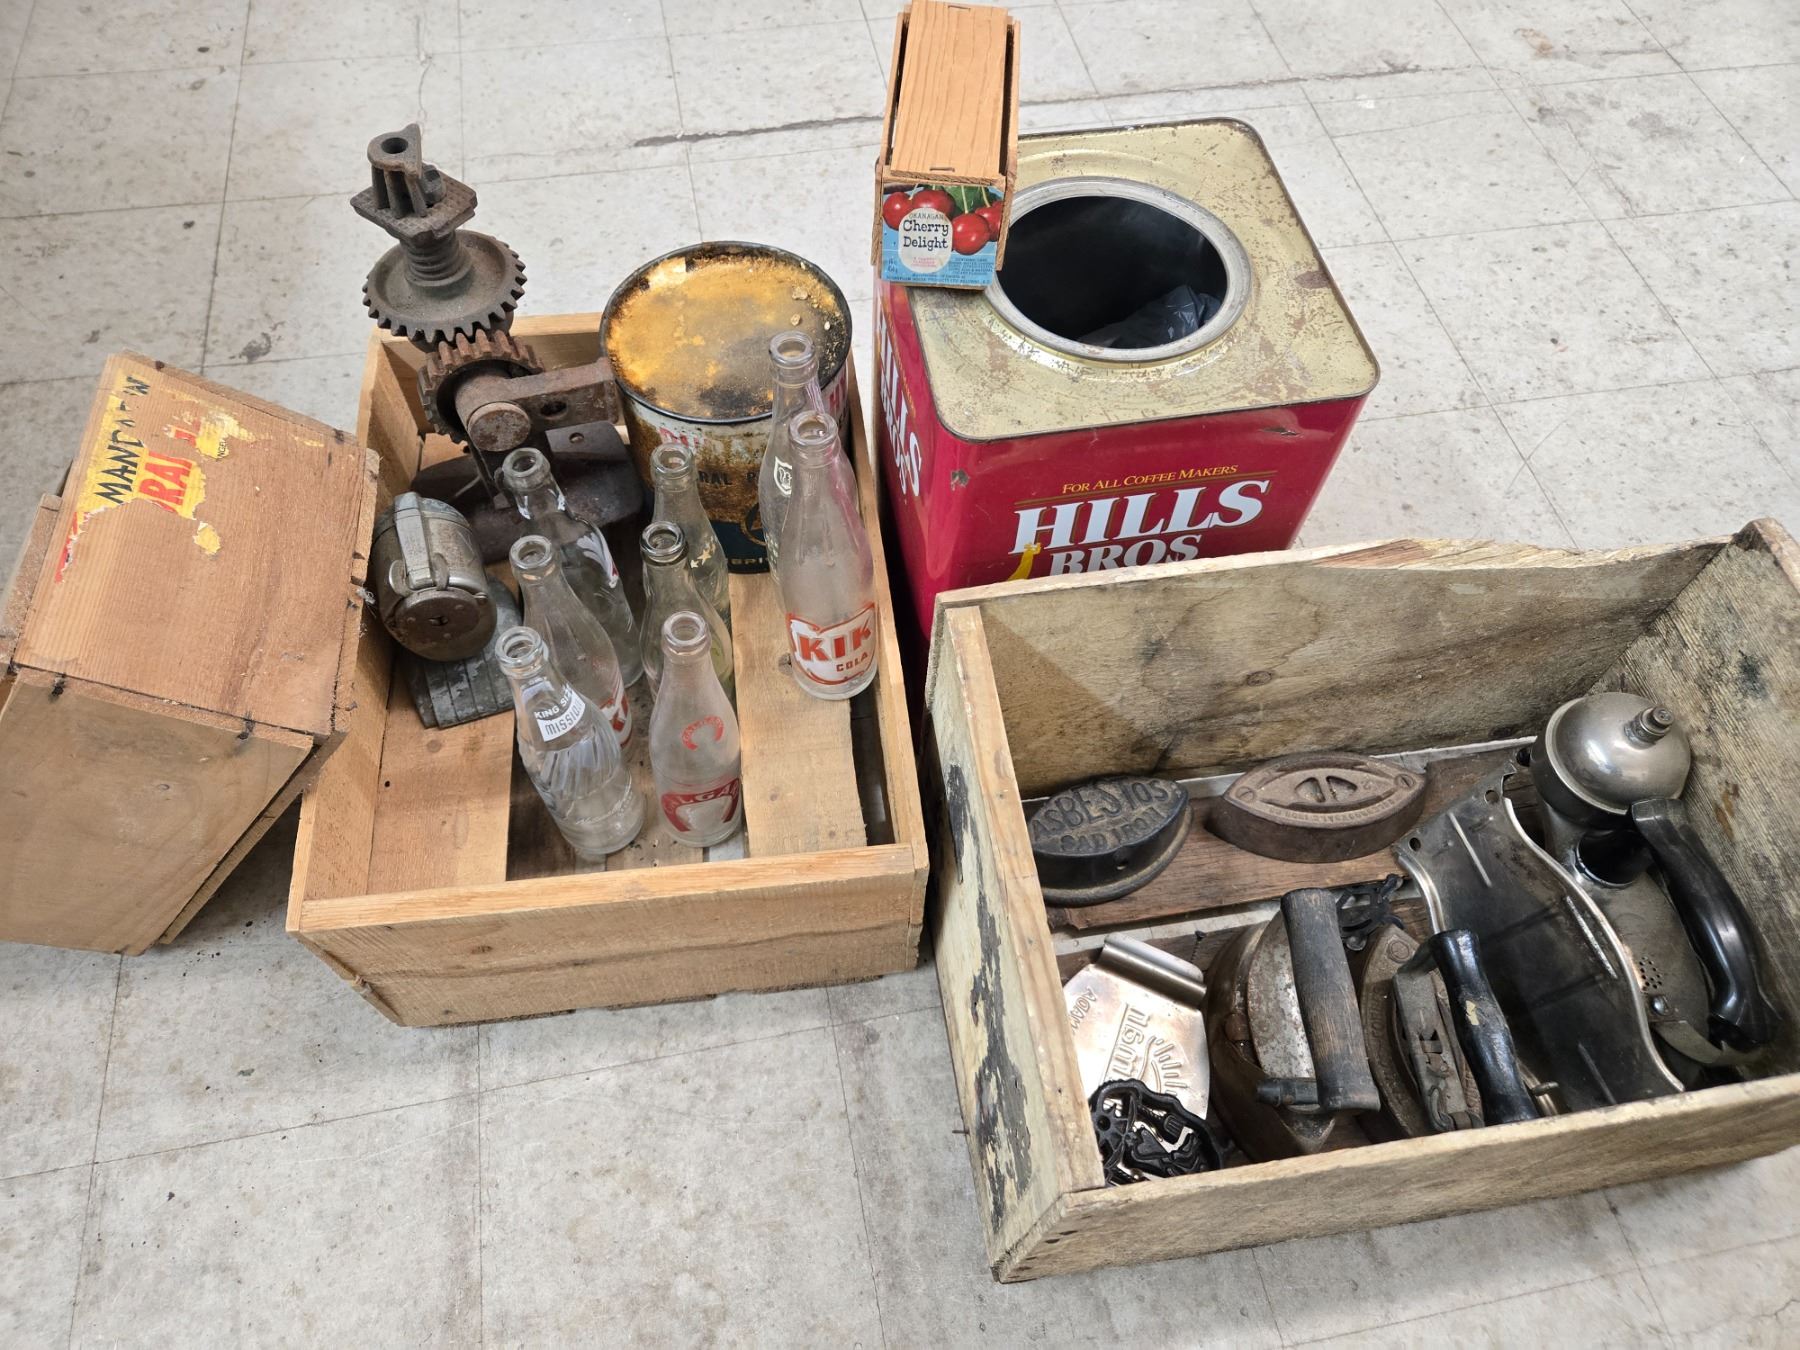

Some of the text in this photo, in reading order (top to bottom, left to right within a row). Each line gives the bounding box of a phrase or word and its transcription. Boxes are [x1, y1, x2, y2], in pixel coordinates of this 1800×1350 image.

[903, 219, 949, 237] Cherry
[903, 235, 949, 251] Delight
[1062, 464, 1238, 494] FOR ALL COFFEE MAKERS
[1008, 480, 1271, 555] HILLS
[1050, 534, 1202, 577] BROS
[799, 619, 872, 662] KIK
[836, 651, 868, 673] COLA
[533, 705, 560, 721] KING
[1030, 779, 1169, 843] ASBESTOS
